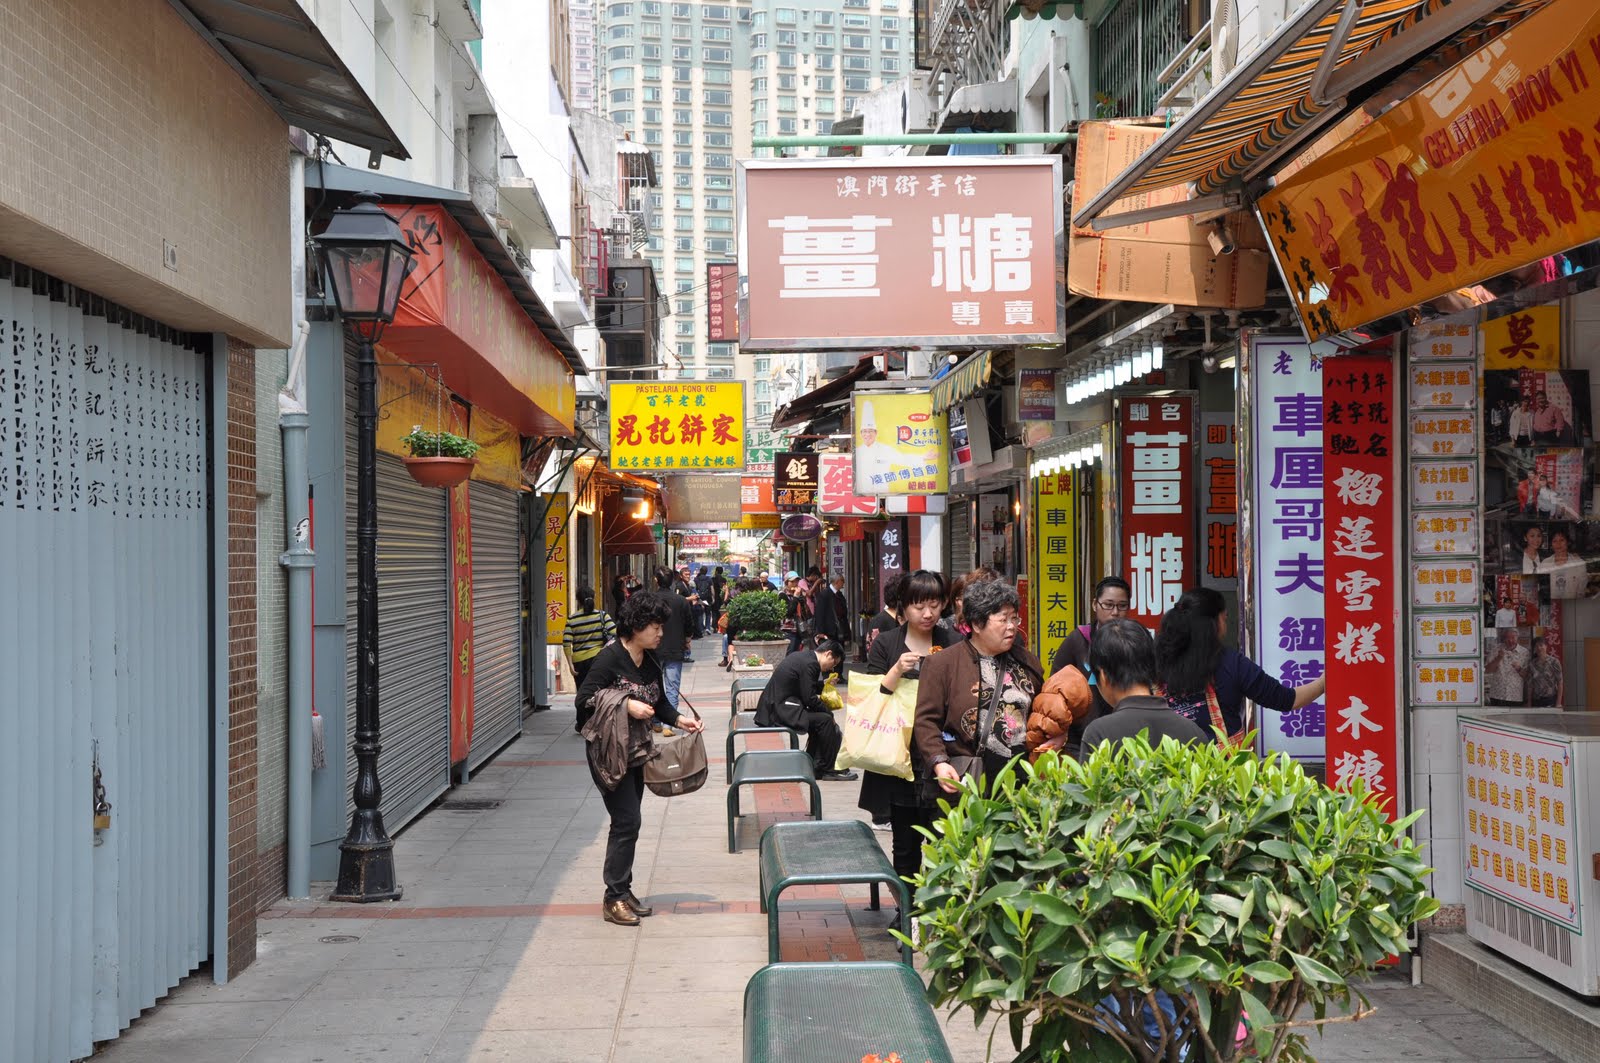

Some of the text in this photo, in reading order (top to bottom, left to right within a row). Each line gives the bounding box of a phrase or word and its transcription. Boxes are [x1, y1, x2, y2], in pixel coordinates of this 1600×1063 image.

[1423, 98, 1510, 169] GELATINA
[1506, 65, 1564, 124] MOK
[1556, 49, 1590, 95] YI
[1304, 155, 1458, 313] 莫義記
[768, 213, 1033, 298] 薑糖
[951, 300, 1034, 326] 專賣
[1499, 314, 1540, 360] 莫
[636, 385, 717, 393] PASTELARIA FONG KEI
[1327, 372, 1389, 396] 八十多年
[646, 394, 706, 408] 百年老號
[1129, 402, 1181, 421] 馳名
[1326, 399, 1389, 426] 老字號
[84, 345, 108, 508] 晃記餅家
[616, 413, 739, 447] 晃記餅家
[1207, 424, 1237, 444] 即
[1414, 419, 1472, 435] 山水豆腐花
[1329, 432, 1389, 458] 馳名
[1432, 441, 1454, 453] $12
[1435, 490, 1454, 501] $12
[1126, 431, 1189, 616] 薑糖
[882, 528, 900, 570] 鉅記
[1434, 539, 1456, 552] $12
[546, 516, 566, 622] 晃記餅家
[1332, 465, 1386, 666] 榴蓮雪糕
[1434, 590, 1456, 603] $12
[1420, 619, 1472, 636] 芒果雪糕
[1438, 642, 1457, 653] $12
[1419, 667, 1474, 683] 燕窩雪糕
[847, 715, 900, 735] In Fashion
[1500, 749, 1515, 883] 芝士蛋糕
[1512, 752, 1528, 888] 芒果雪糕
[1525, 755, 1540, 894] 朱古力雪糕
[1537, 757, 1555, 899] 燕窩雪糕
